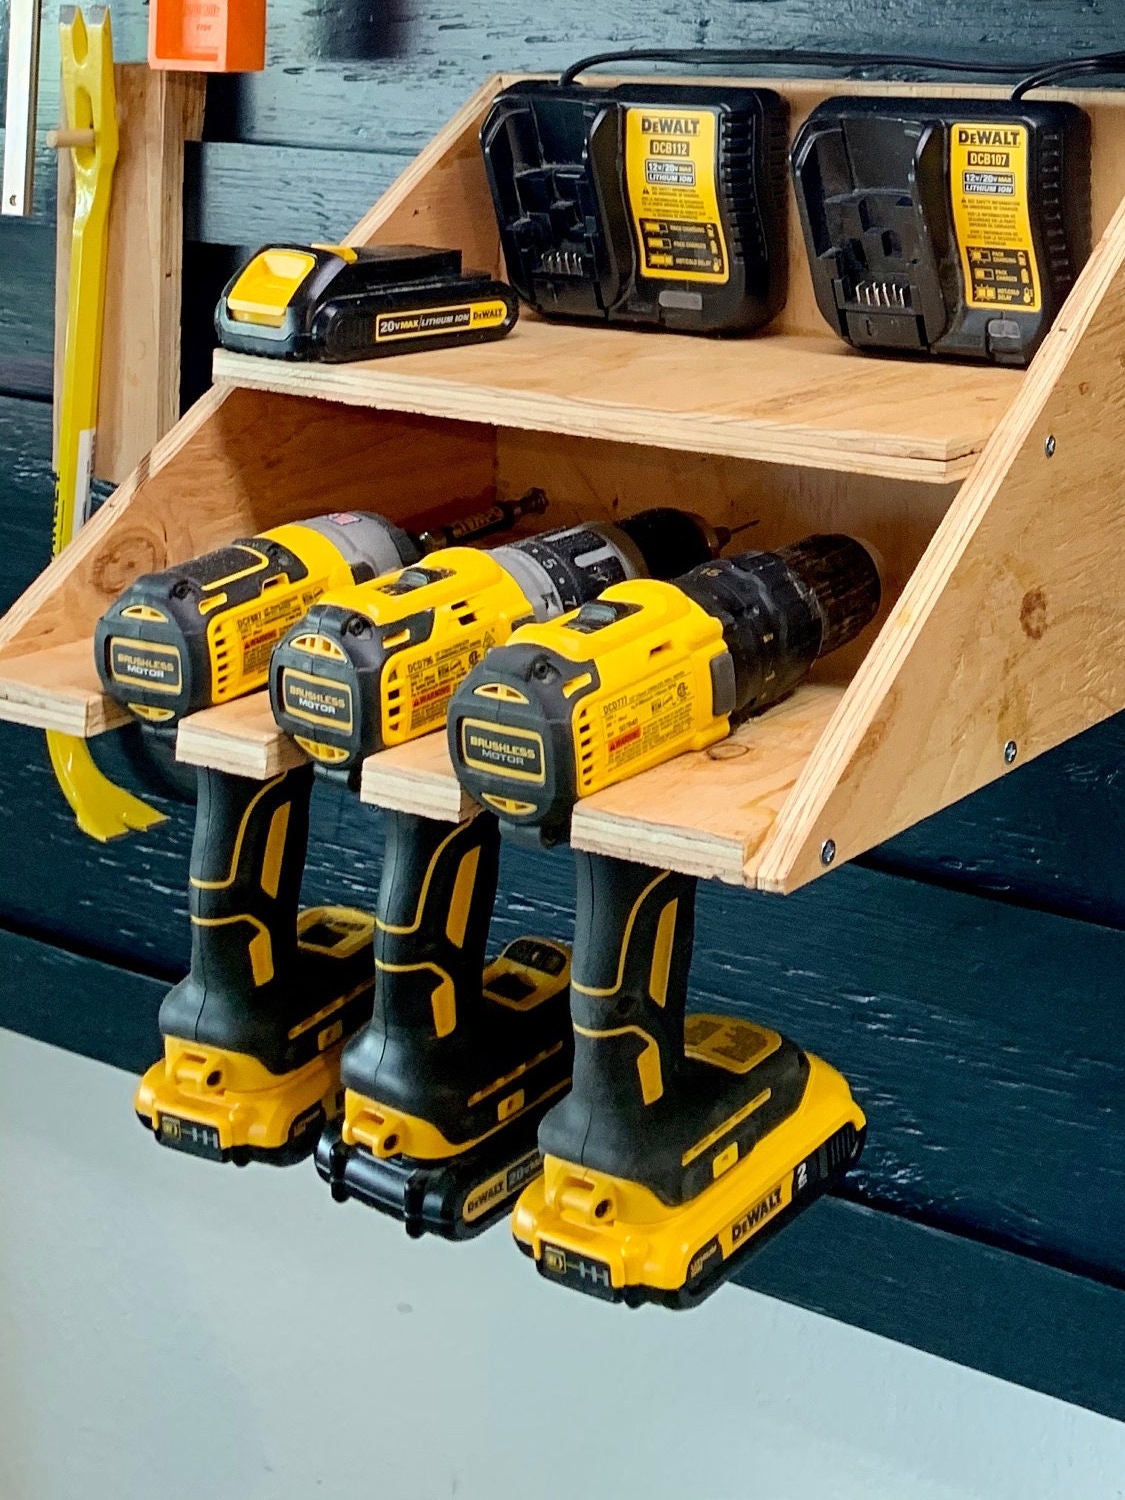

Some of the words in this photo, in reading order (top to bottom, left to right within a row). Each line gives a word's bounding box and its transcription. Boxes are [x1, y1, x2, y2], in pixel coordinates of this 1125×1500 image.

[958, 129, 1020, 146] DEWALT
[652, 140, 688, 156] DCB112
[969, 152, 1007, 166] DCB107
[454, 313, 470, 323] ION
[117, 652, 175, 673] BRUSHLESS
[126, 663, 165, 679] MOTOR
[289, 684, 346, 709] BRUSHLESS
[298, 696, 336, 715] MOTOR
[469, 735, 536, 760] BRUSHLESS
[481, 748, 525, 766] MOTOR
